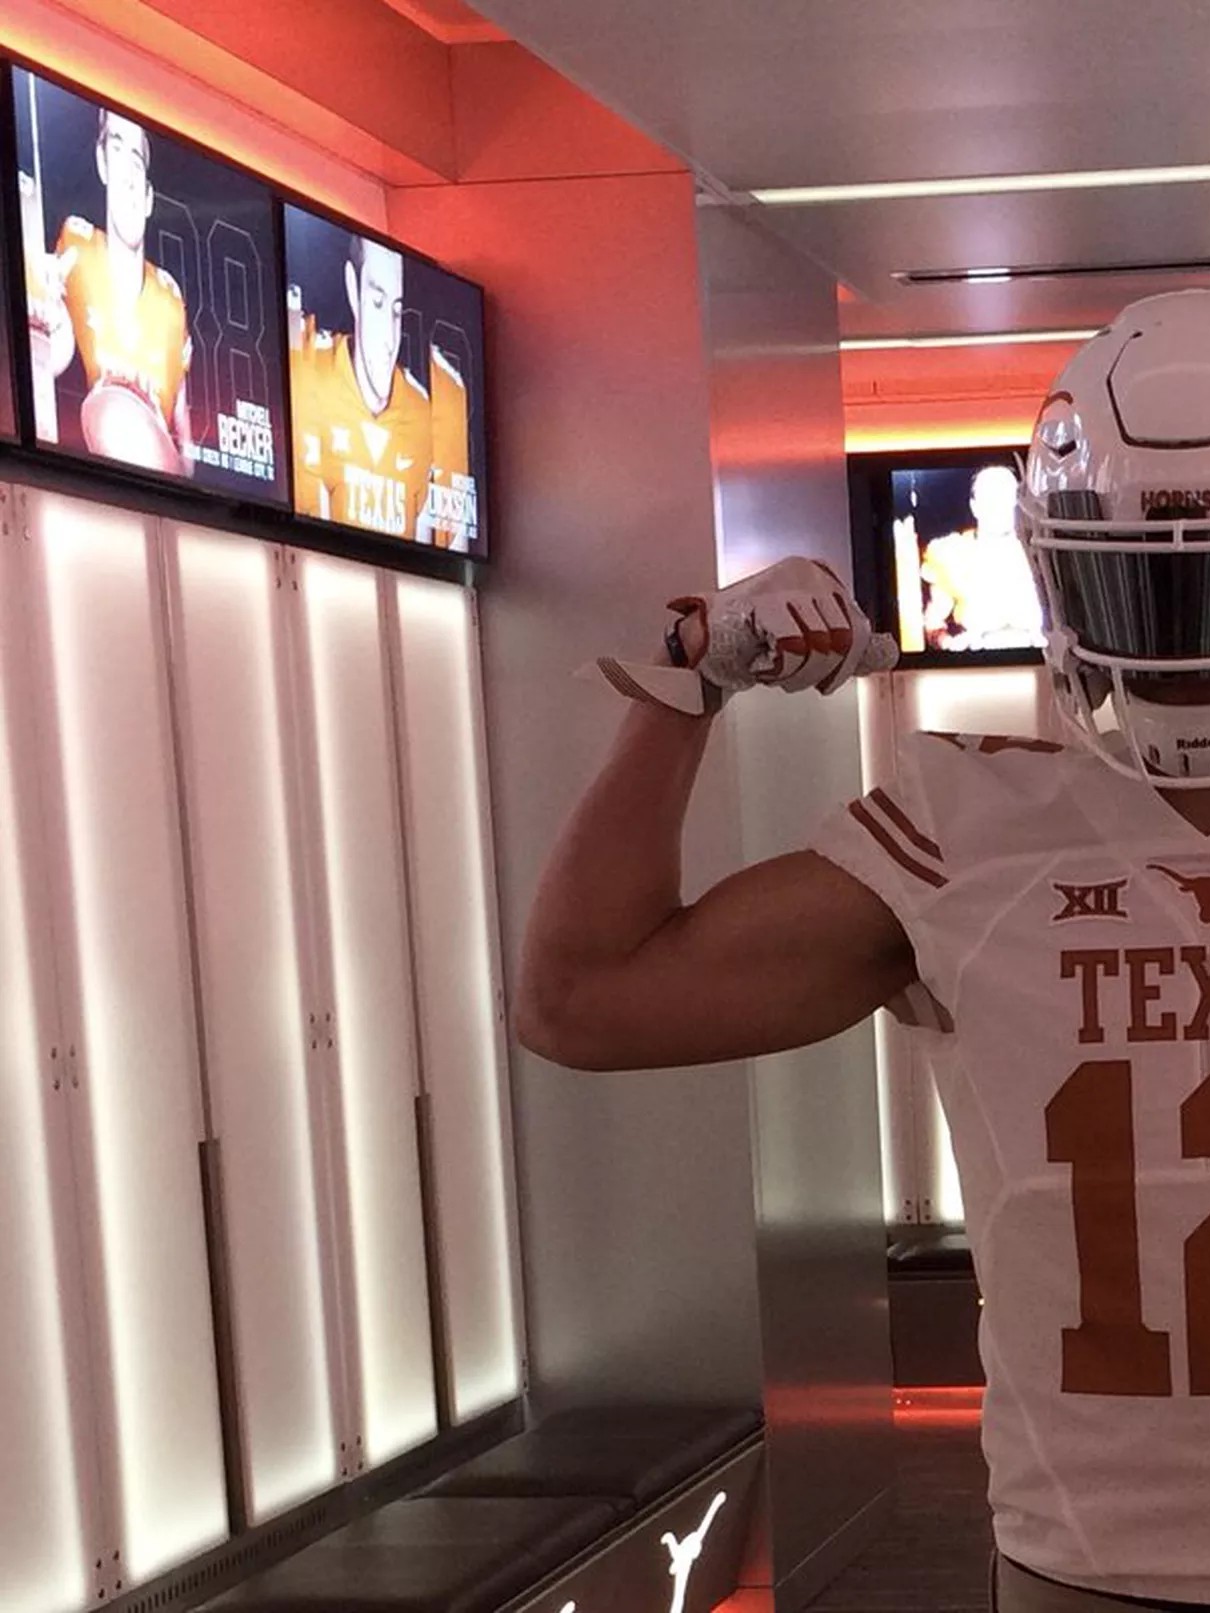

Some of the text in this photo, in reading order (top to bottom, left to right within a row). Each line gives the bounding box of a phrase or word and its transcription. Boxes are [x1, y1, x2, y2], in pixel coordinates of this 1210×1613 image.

[217, 412, 274, 467] BECKER
[343, 463, 406, 536] TEXAS
[1052, 879, 1128, 921] XII
